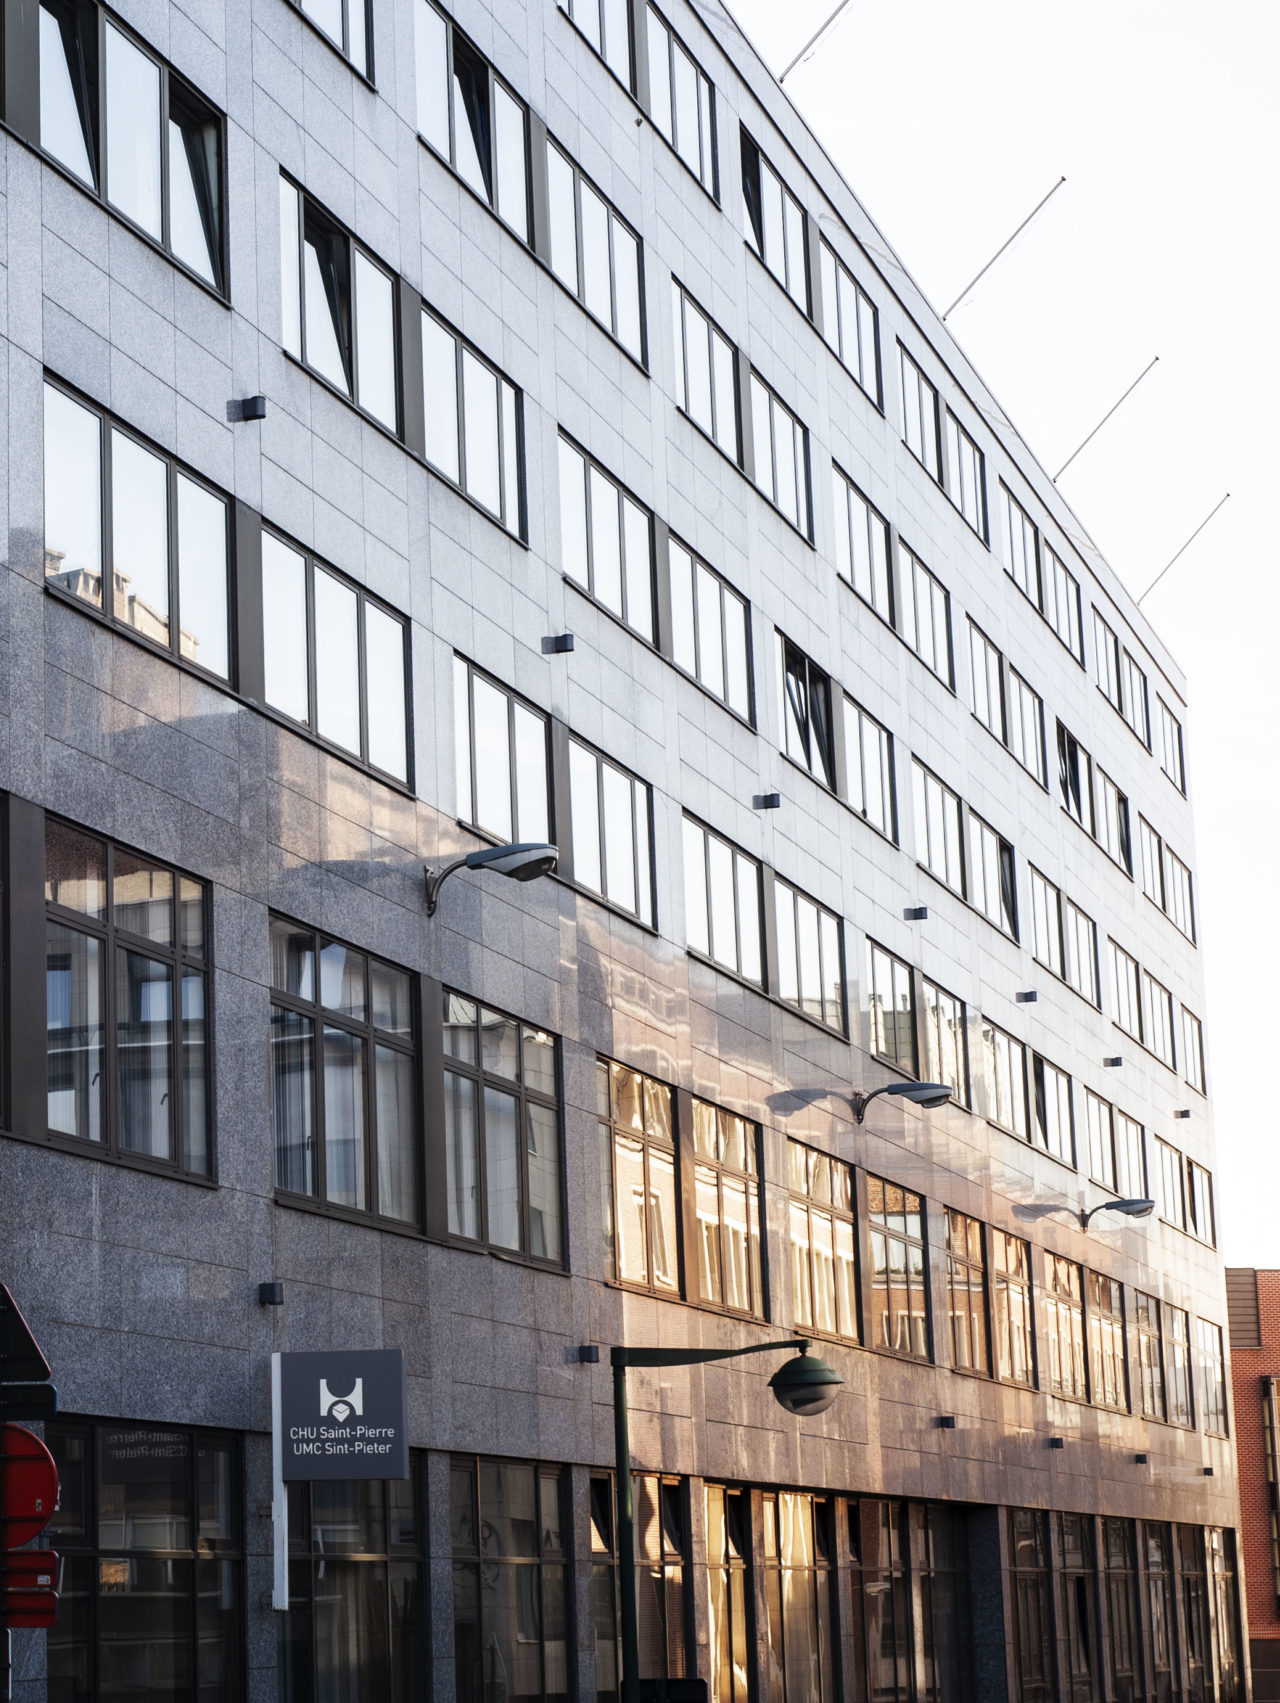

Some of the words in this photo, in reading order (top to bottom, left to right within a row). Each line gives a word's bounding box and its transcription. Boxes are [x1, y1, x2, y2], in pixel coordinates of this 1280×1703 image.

[290, 1426, 317, 1439] CHU
[320, 1425, 395, 1439] Saint-Pierre
[293, 1442, 322, 1455] UMC
[325, 1441, 392, 1455] Sint-Pieter
